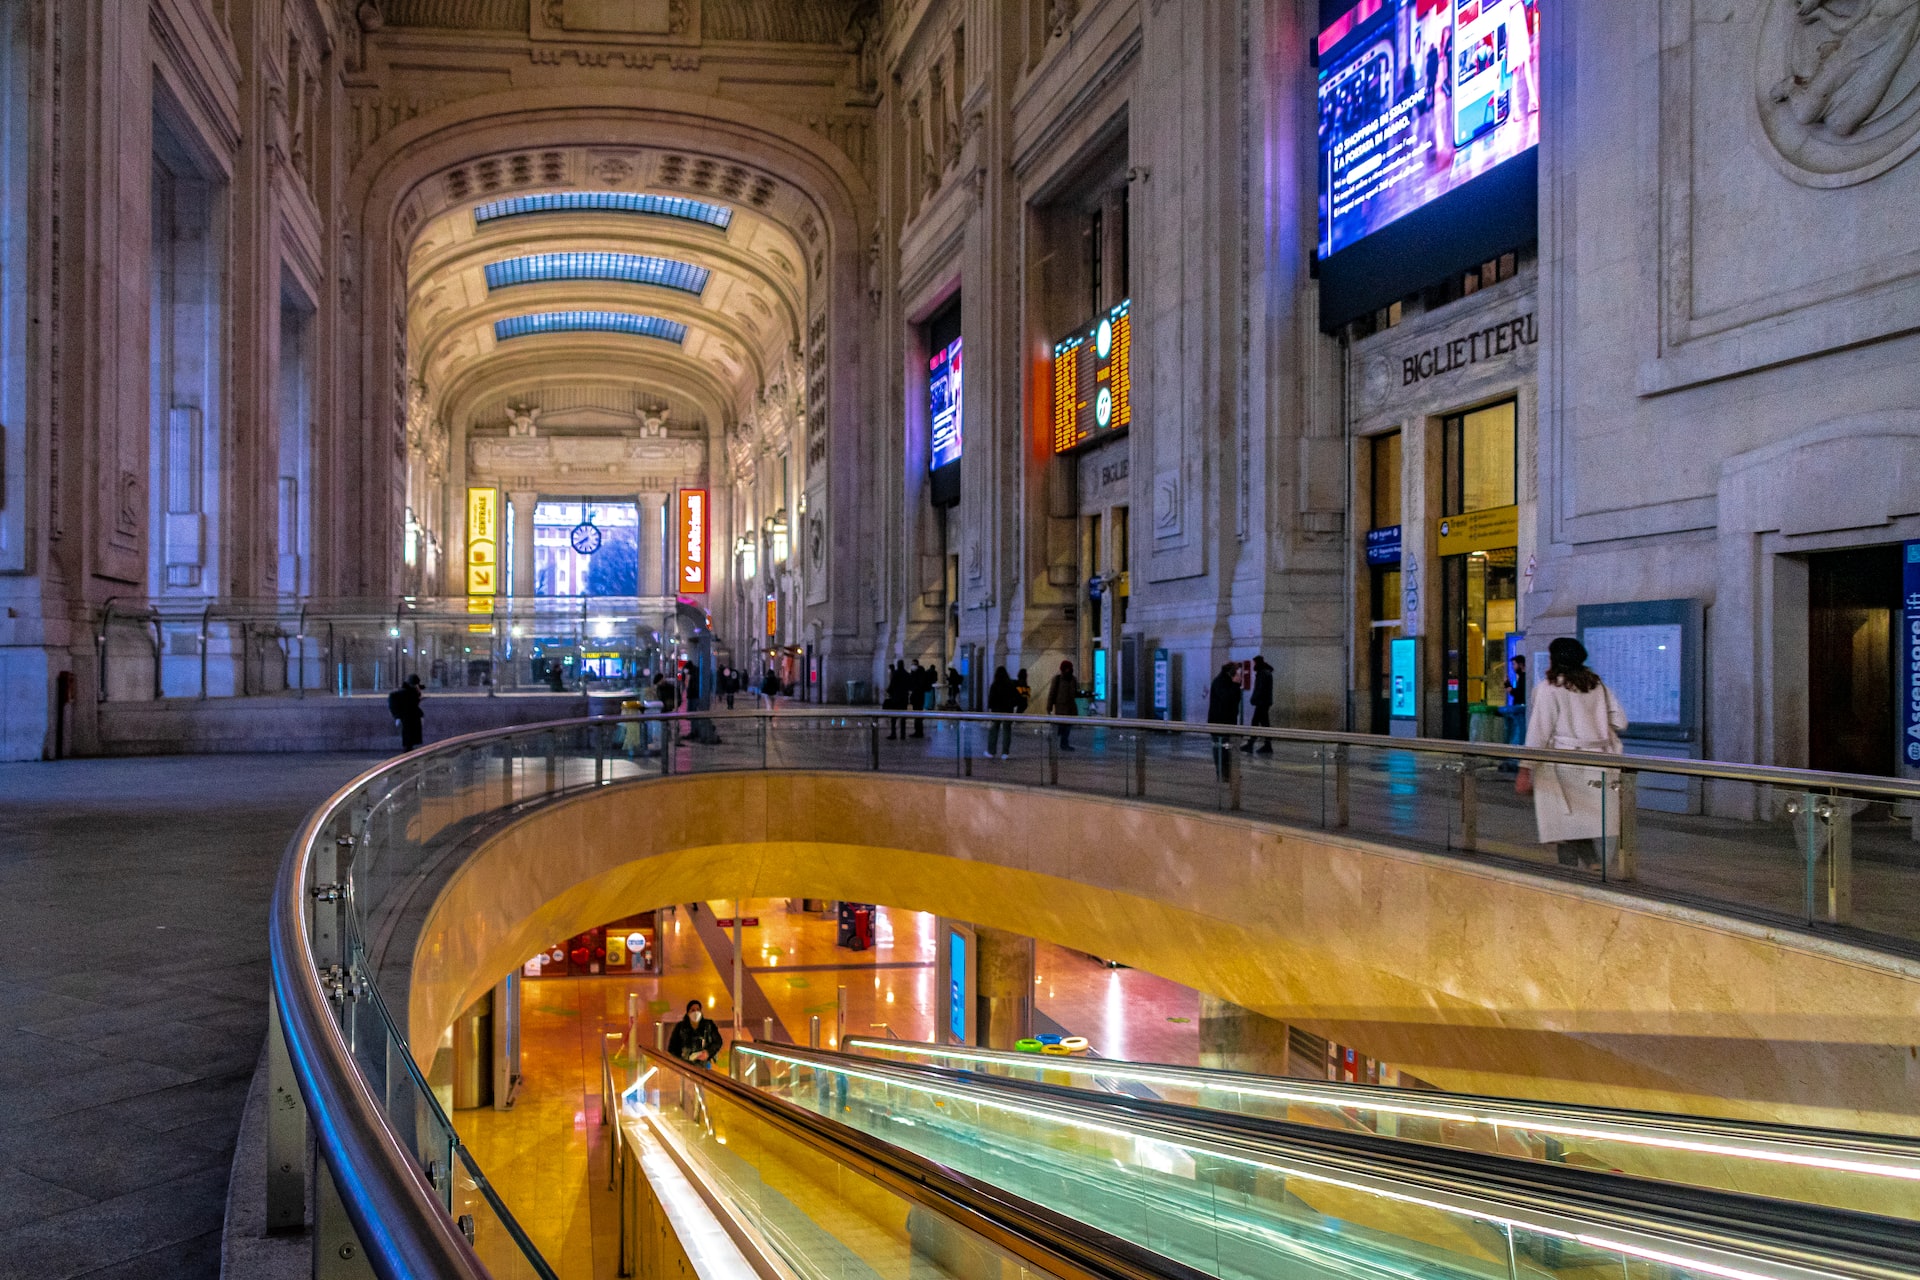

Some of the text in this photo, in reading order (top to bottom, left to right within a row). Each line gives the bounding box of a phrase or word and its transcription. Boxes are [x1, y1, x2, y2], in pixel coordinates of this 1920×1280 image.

[1334, 143, 1344, 157] LO
[1344, 119, 1379, 151] SHOPPING
[1389, 87, 1425, 121] STAZIONE
[1345, 138, 1375, 165] PORTATA
[478, 496, 486, 536] CENTRALE
[1450, 518, 1467, 528] Treni
[1907, 620, 1920, 741] Ascensore
